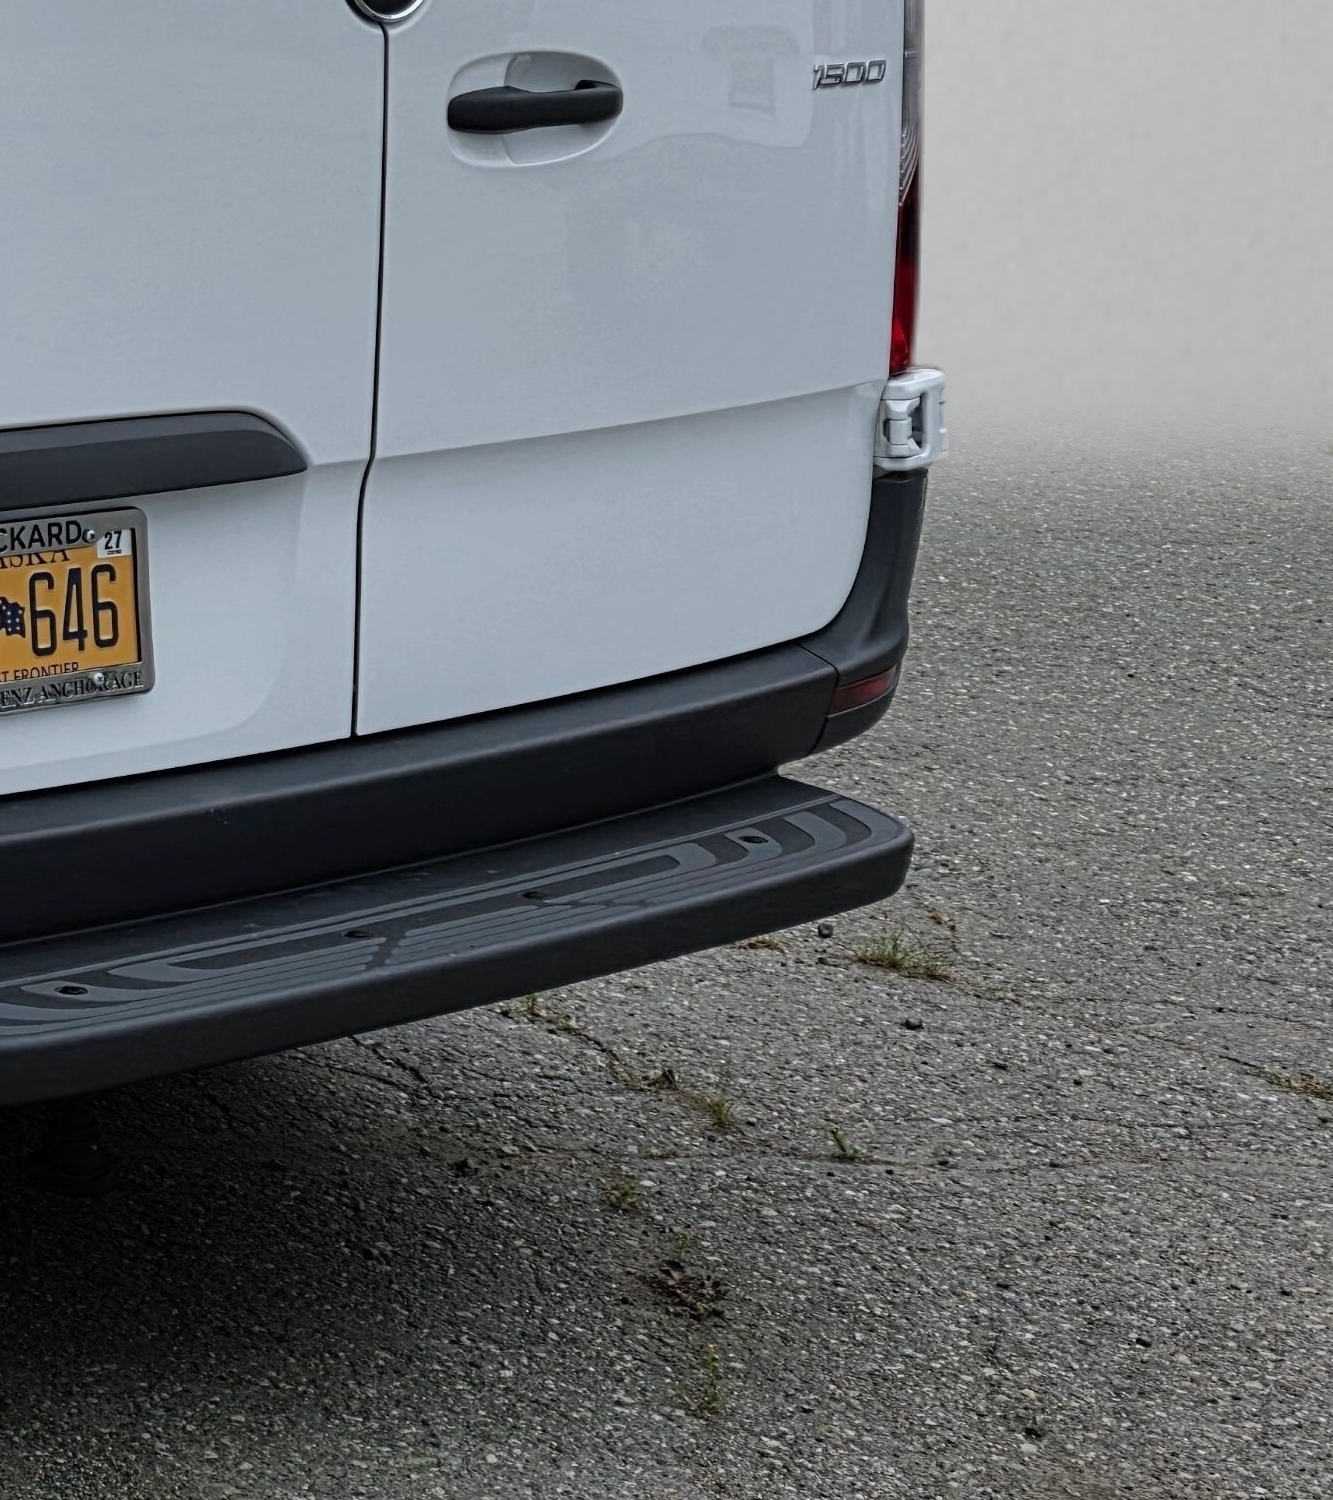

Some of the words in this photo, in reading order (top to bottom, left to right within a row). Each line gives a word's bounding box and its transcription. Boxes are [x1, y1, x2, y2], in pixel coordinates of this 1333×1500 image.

[812, 59, 886, 91] 1500
[104, 530, 122, 550] 27
[29, 564, 119, 657] 646
[14, 661, 79, 681] FRONTIER
[39, 670, 144, 701] ANCHORAGE
